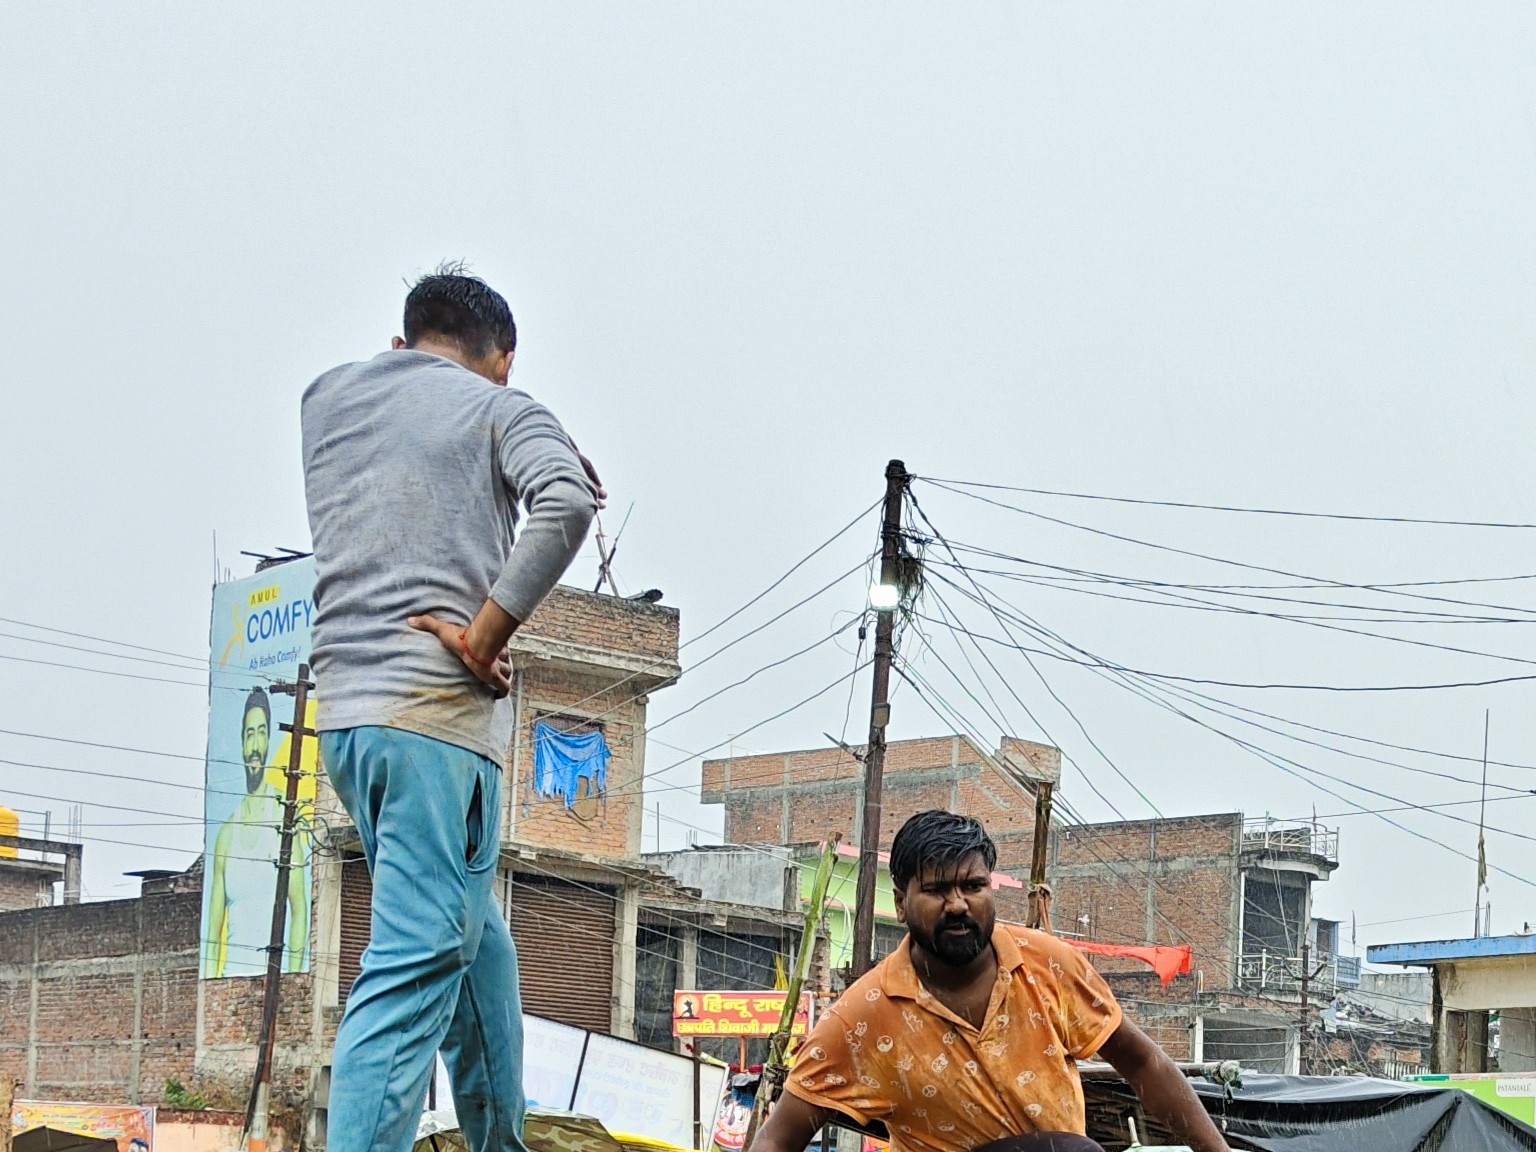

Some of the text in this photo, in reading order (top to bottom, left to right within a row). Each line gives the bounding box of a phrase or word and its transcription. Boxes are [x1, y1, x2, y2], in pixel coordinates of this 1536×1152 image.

[250, 587, 278, 605] AMUL
[247, 599, 313, 643] COMFY
[702, 994, 753, 1018] हिन्दू
[718, 1018, 760, 1034] शिवाजी
